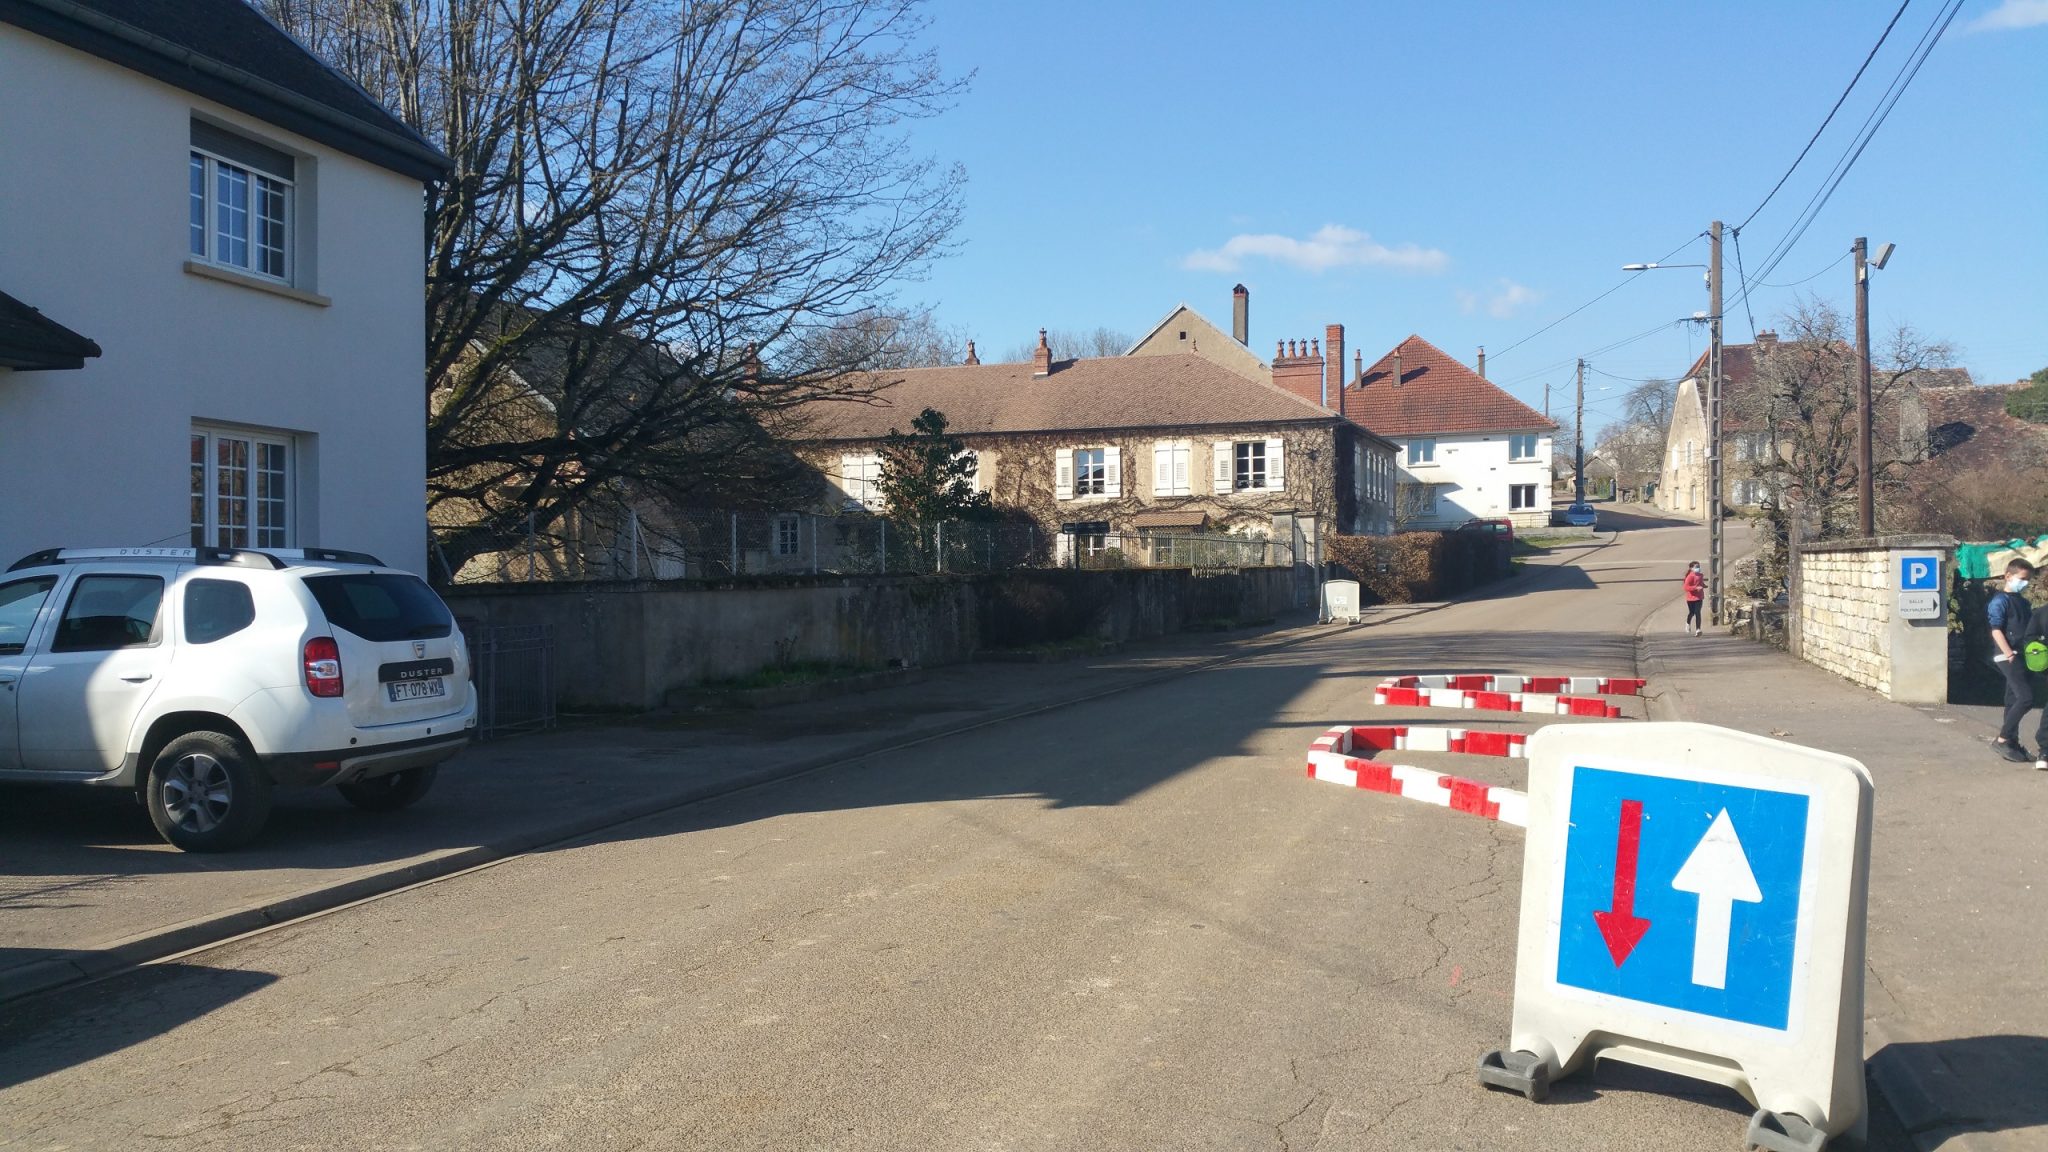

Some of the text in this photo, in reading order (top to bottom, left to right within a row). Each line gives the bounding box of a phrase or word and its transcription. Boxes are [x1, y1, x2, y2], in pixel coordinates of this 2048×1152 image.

[120, 548, 191, 556] DUSTER
[1910, 562, 1928, 585] P
[401, 667, 443, 678] DUSTER
